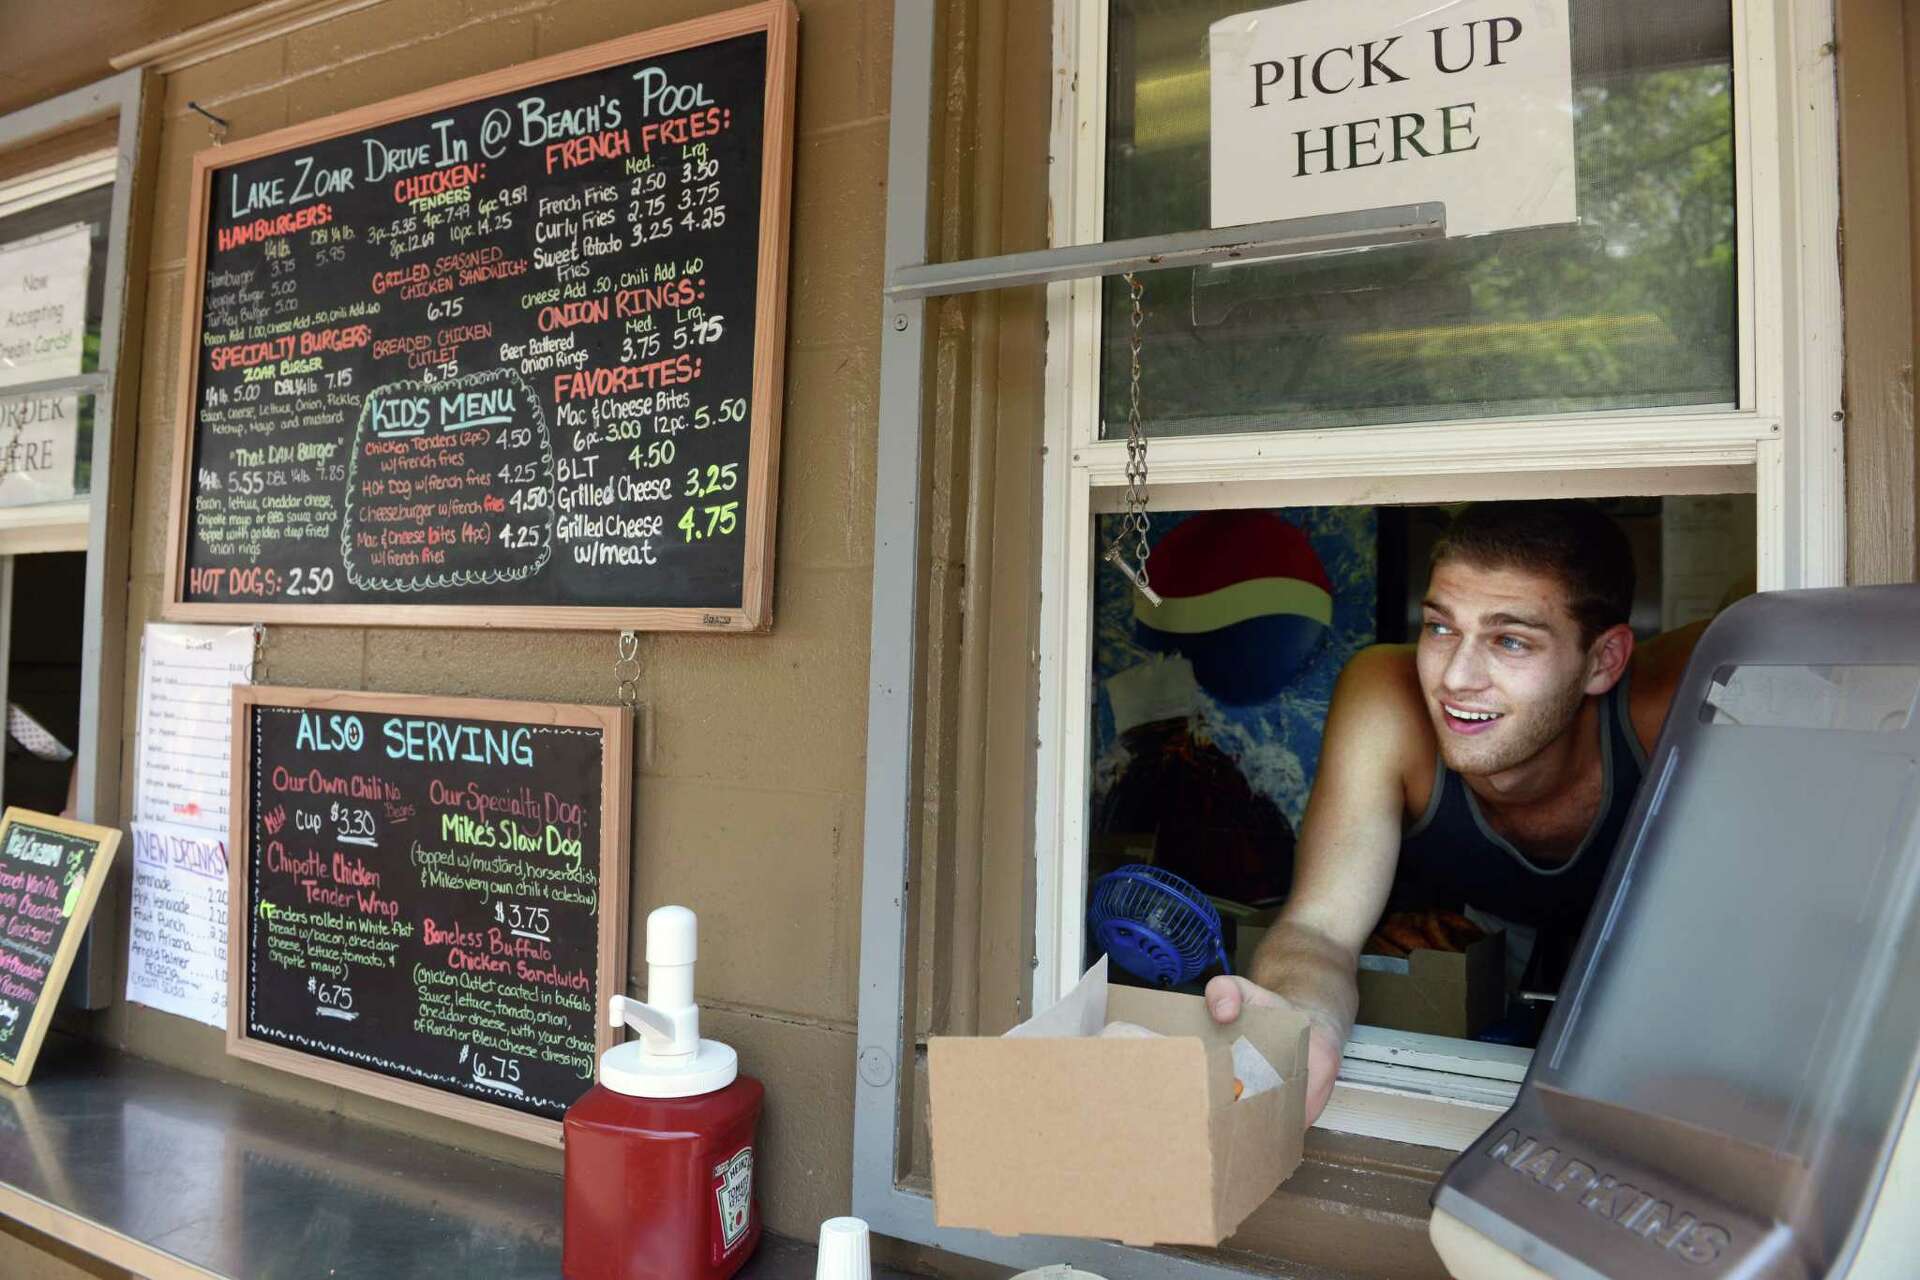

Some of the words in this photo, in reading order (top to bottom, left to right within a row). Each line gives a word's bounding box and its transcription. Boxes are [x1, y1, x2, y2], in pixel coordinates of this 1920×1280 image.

[1249, 36, 1410, 109] PICK
[1426, 16, 1522, 74] UP
[232, 174, 284, 218] LAKE
[290, 157, 354, 204] ZOAR
[363, 139, 430, 182] DRIVE
[518, 96, 622, 147] BEACH'S
[633, 67, 714, 117] POOL
[546, 129, 630, 174] FRENCH
[642, 107, 731, 153] FRIES:
[1291, 102, 1481, 178] HERE
[394, 163, 487, 203] CHICKEN:
[409, 186, 471, 214] TENDERS
[539, 194, 581, 217] French
[584, 185, 619, 206] Fries
[630, 172, 666, 196] 2.50
[681, 160, 718, 183] 3.50
[219, 204, 332, 251] HAMBURGERS:
[391, 217, 416, 237] 5.35
[536, 219, 578, 245] Curly
[583, 210, 615, 230] Fries
[628, 195, 666, 222] 2.75
[678, 181, 720, 210] 3.75
[533, 245, 580, 270] Sweet
[583, 234, 622, 256] Potato
[630, 218, 672, 247] 3.25
[680, 205, 726, 231] 4.25
[372, 264, 430, 294] GRILLED
[434, 246, 503, 275] SEASONED
[401, 276, 453, 300] CHICKEN
[522, 289, 559, 309] Cheese
[564, 281, 587, 298] Add
[620, 269, 648, 286] Chili
[654, 262, 675, 281] Add
[557, 261, 590, 283] Fries
[427, 297, 464, 321] 6.75
[538, 296, 608, 332] ONION
[616, 278, 705, 318] RINGS:
[212, 335, 296, 371] SPECIALTY
[301, 324, 371, 355] BURGERS:
[373, 336, 431, 360] BREADED
[438, 322, 492, 345] CHICKEN
[408, 346, 459, 369] CUTLET
[500, 343, 524, 361] Beer
[529, 331, 574, 356] Battered
[556, 348, 589, 370] Rings
[620, 333, 661, 362] 3.75
[673, 315, 724, 350] 5.75
[243, 365, 275, 383] ZOAR
[280, 358, 323, 375] BURGER
[424, 361, 458, 384] 6.75
[555, 354, 702, 403] FAVORITES:
[234, 385, 261, 402] 5.00
[372, 397, 430, 431] KID'S
[441, 389, 516, 425] MENU
[557, 403, 587, 426] Mac
[602, 396, 652, 420] Cheese
[656, 389, 690, 412] Bites
[281, 417, 299, 429] and
[605, 420, 641, 442] 3.00
[694, 398, 746, 430] 5.50
[365, 441, 409, 456] Chicken
[411, 434, 457, 452] Tenders
[496, 428, 531, 450] 4.50
[558, 455, 599, 482] BLT
[628, 440, 675, 470] 4.50
[228, 471, 265, 495] 5.55
[498, 462, 537, 483] 4.25
[558, 476, 614, 512] Grilled
[618, 476, 672, 502] Cheese
[684, 463, 738, 498] 3.25
[360, 504, 435, 525] Cheeseburger
[509, 486, 547, 514] 4.50
[557, 514, 603, 543] Grilled
[606, 515, 663, 538] Cheese
[678, 501, 738, 543] 4.75
[357, 532, 378, 548] Mac
[428, 526, 456, 545] bites
[499, 523, 540, 548] 4.25
[574, 540, 657, 566] w/meat
[191, 568, 225, 595] HOT
[229, 568, 282, 596] DOGS:
[286, 567, 334, 596] 2.50
[296, 713, 364, 751] ALSO
[382, 717, 534, 768] SERVING
[273, 766, 308, 791] Our
[309, 769, 348, 796] Own
[351, 776, 381, 800] Chili
[296, 809, 321, 834] Cup
[430, 779, 464, 805] Our
[466, 782, 542, 837] Specialty
[136, 830, 168, 864] NEW
[171, 836, 224, 875] DRINKS
[442, 813, 495, 848] Mike's
[500, 819, 542, 854] Slaw
[546, 824, 582, 870] Dog
[267, 841, 328, 886] Chipotle
[333, 852, 381, 889] Chicken
[302, 879, 353, 906] Tender
[357, 890, 398, 922] Wrap
[465, 877, 489, 904] very
[490, 882, 513, 894] own
[269, 921, 296, 936] bread
[310, 912, 343, 930] rolled
[346, 917, 356, 931] in
[392, 921, 414, 937] flat
[424, 918, 483, 947] Boneless
[488, 928, 552, 961] Buffalo
[449, 948, 511, 975] Chicken
[517, 962, 590, 992] Sandwich
[460, 973, 496, 993] Cutlet
[498, 984, 538, 1004] coated
[541, 990, 551, 1003] in
[555, 990, 591, 1012] buffalo
[426, 1020, 458, 1039] Ranch
[458, 1031, 471, 1041] or
[472, 1031, 497, 1047] Bleu
[511, 1022, 535, 1038] with
[538, 1030, 562, 1046] your
[1487, 1128, 1731, 1265] NAPKINS
